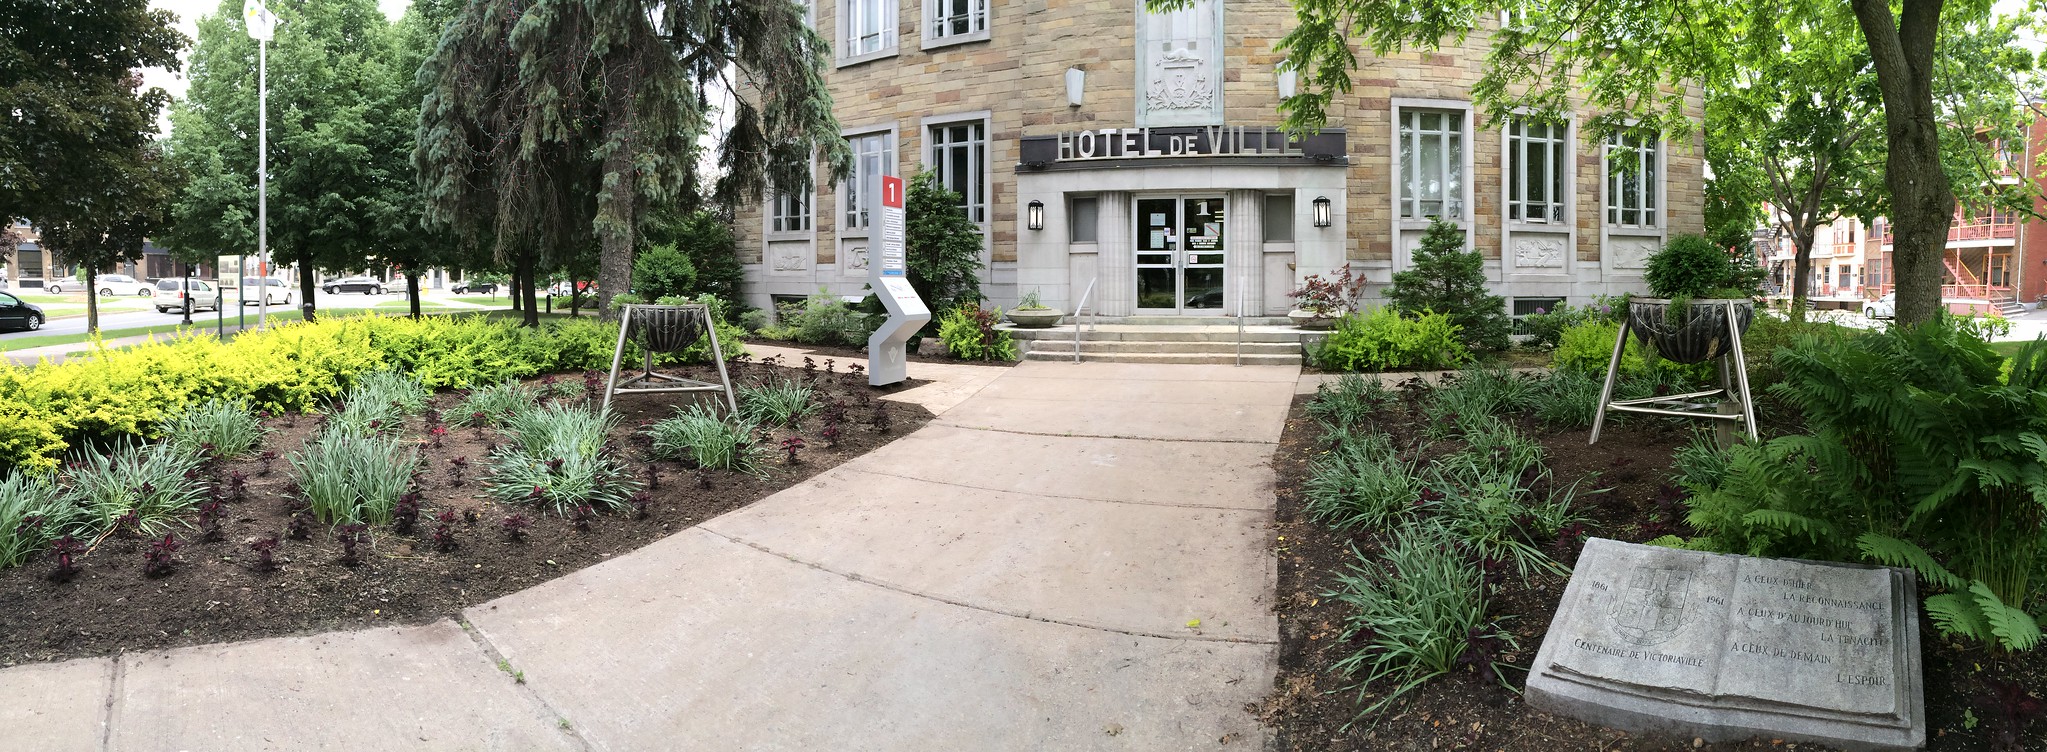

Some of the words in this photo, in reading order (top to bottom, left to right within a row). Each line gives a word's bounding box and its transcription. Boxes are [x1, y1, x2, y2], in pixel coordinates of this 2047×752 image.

[1057, 127, 1162, 159] HOTEL
[1170, 135, 1198, 156] DE
[1206, 125, 1303, 155] VILLE
[888, 182, 895, 203] 1
[1196, 201, 1211, 216] 1
[1591, 580, 1609, 592] 1861
[1754, 575, 1779, 585] CEUX
[1783, 578, 1813, 590] D'HIER
[1706, 595, 1725, 606] 1961
[1783, 592, 1795, 602] LA
[1799, 594, 1885, 611] RECONNAISSANCE
[1748, 608, 1775, 619] CEUX
[1821, 632, 1834, 643] LA
[1574, 638, 1626, 658] CENTENAIRE
[1629, 650, 1639, 660] DE
[1643, 650, 1705, 668] VICTORIAVILLE
[1741, 643, 1768, 655] CEUX
[1774, 648, 1786, 658] DE
[1790, 651, 1832, 664] DEMAIN
